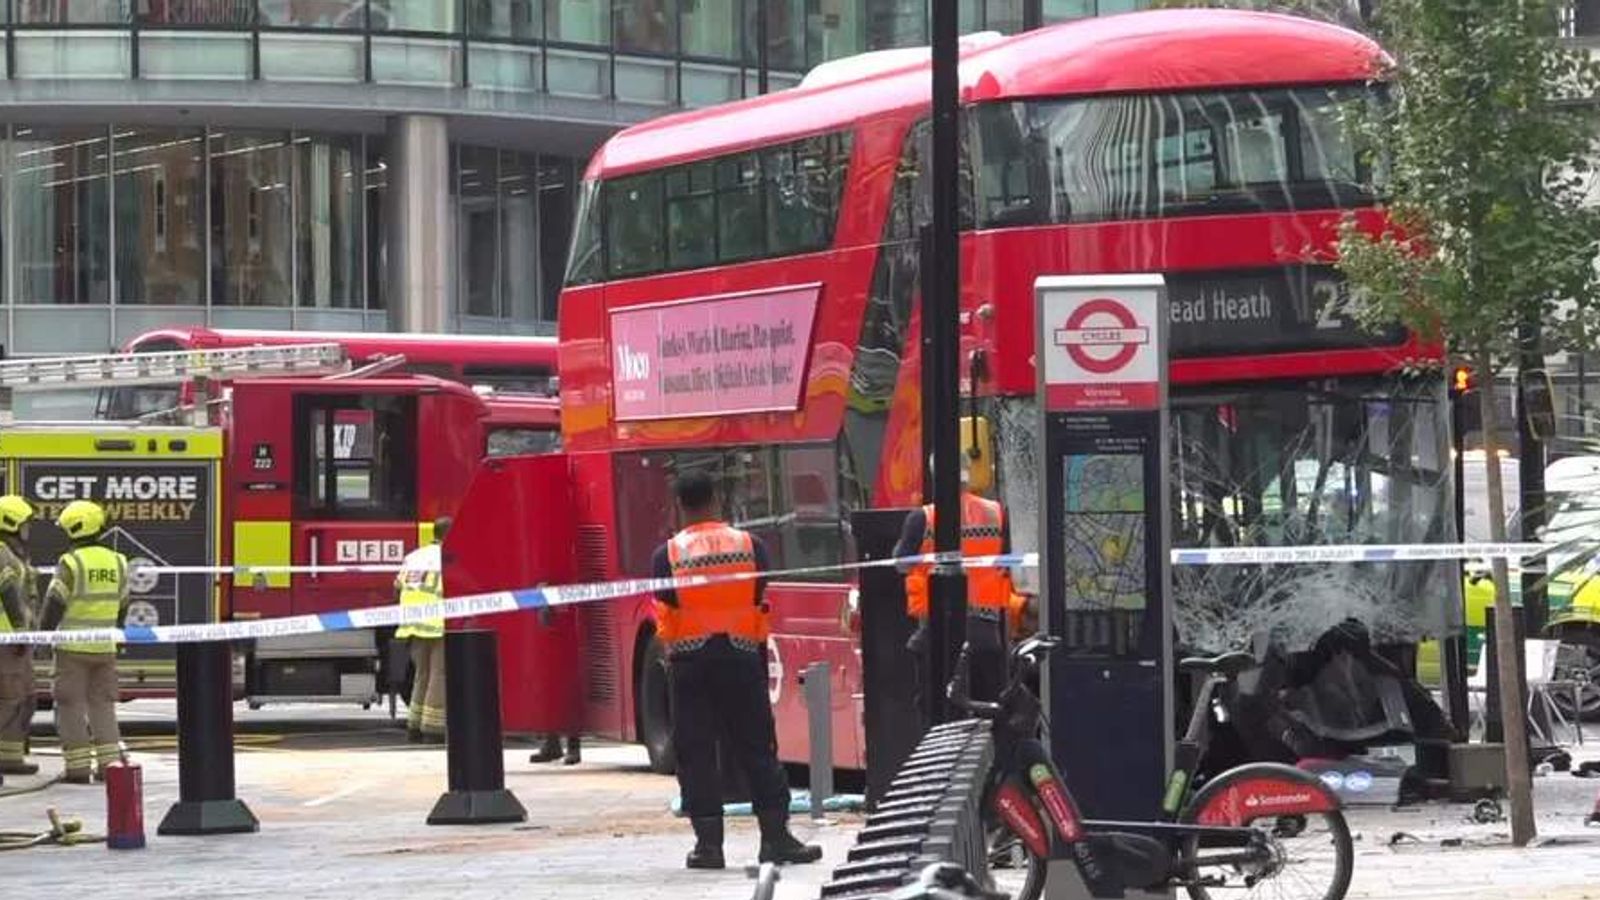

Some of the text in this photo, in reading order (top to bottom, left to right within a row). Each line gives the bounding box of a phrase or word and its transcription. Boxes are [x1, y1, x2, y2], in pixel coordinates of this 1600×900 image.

[1212, 286, 1271, 320] Heath
[1081, 331, 1121, 341] CYCLES
[34, 475, 198, 500] GET MORE
[105, 501, 196, 521] WEEKLY
[88, 567, 118, 584] FIRE
